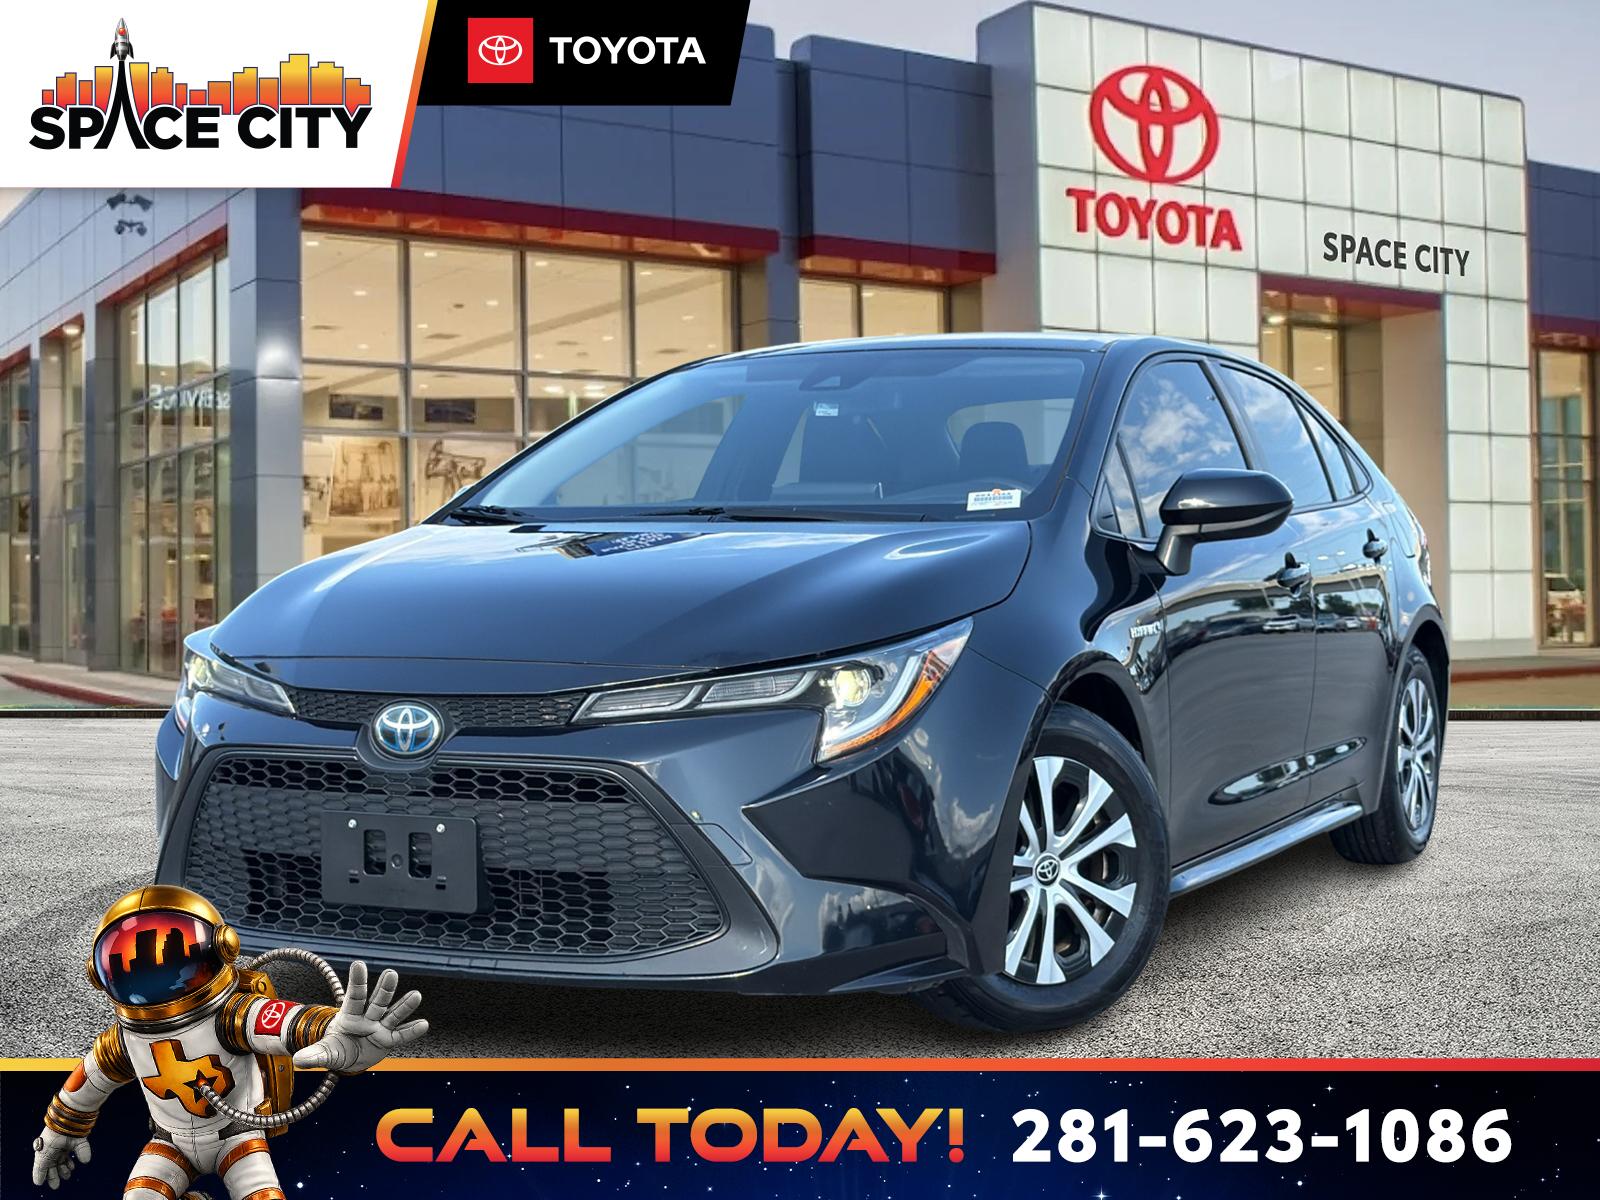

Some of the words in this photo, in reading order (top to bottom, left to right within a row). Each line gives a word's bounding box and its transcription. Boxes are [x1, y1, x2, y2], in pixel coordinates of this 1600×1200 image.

[1066, 188, 1243, 252] TOYOTA
[1323, 231, 1408, 270] SPACE
[1414, 245, 1471, 277] CITY
